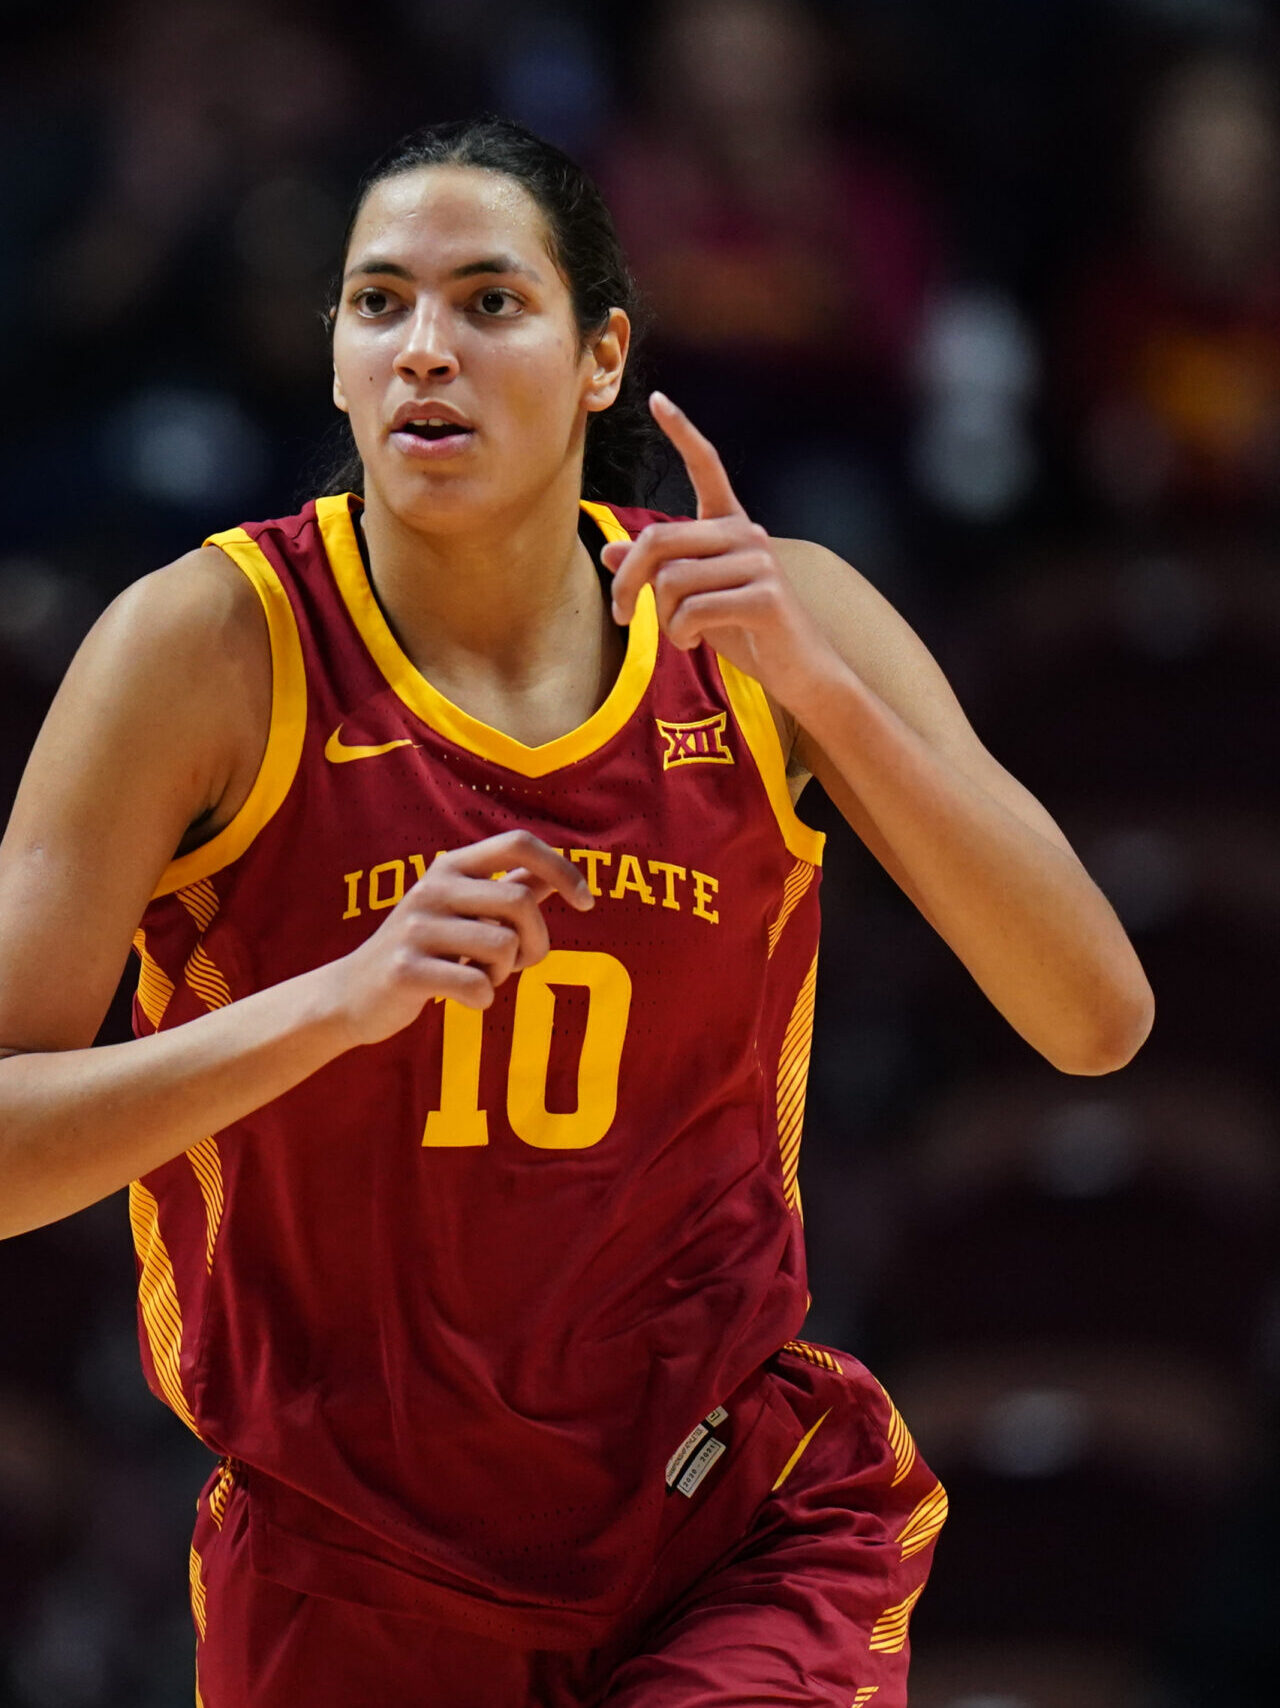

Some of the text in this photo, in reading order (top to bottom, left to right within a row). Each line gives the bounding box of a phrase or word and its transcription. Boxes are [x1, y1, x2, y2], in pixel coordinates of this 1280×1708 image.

[658, 715, 731, 767] XII
[342, 847, 720, 925] IO TATE
[421, 949, 633, 1150] 10
